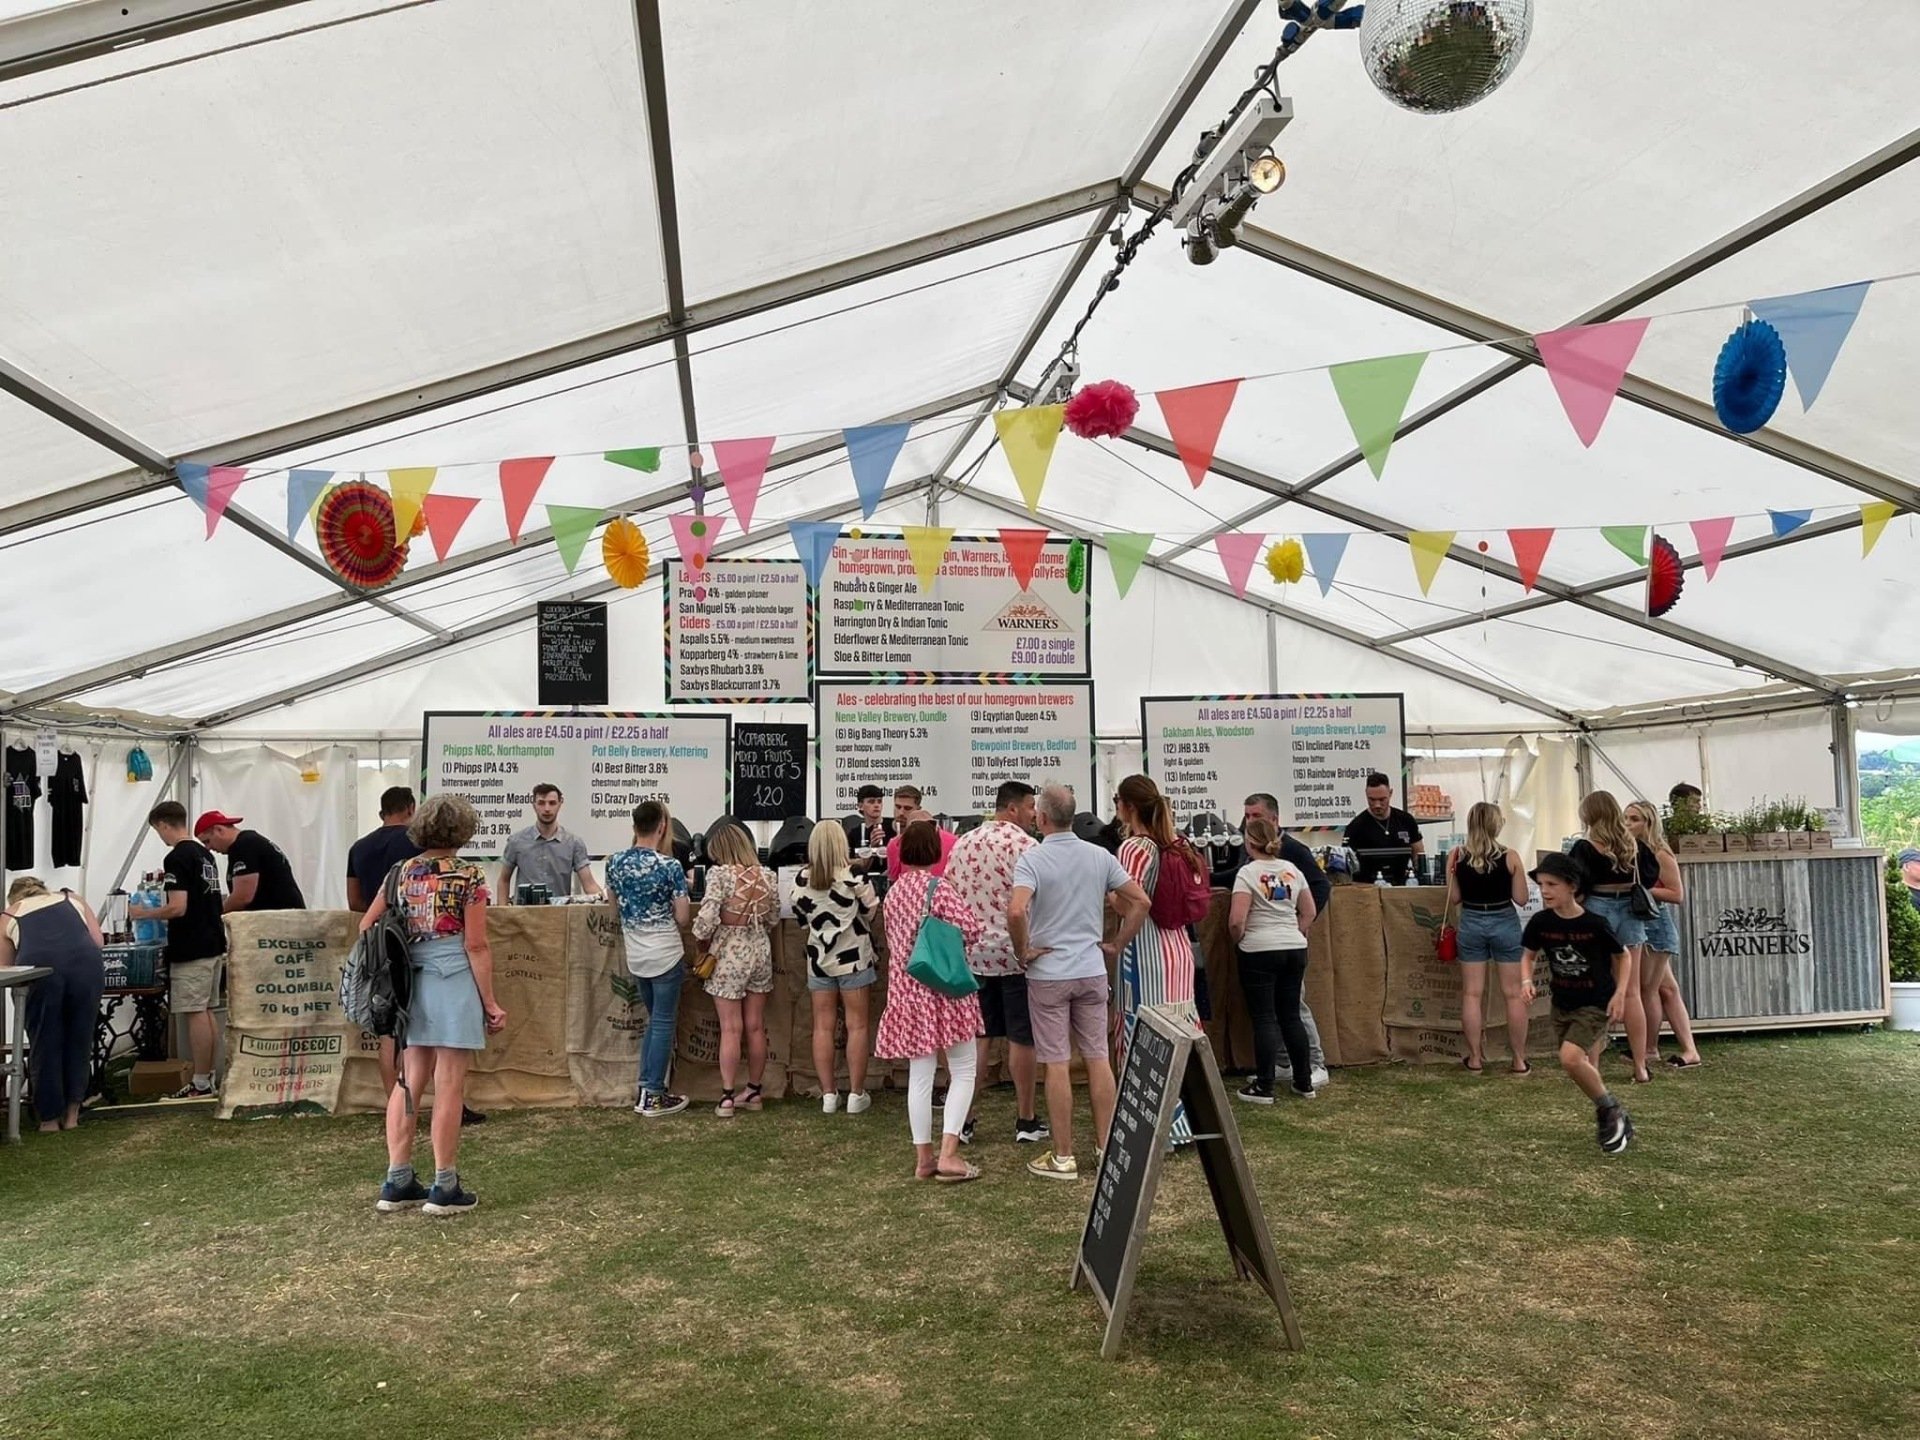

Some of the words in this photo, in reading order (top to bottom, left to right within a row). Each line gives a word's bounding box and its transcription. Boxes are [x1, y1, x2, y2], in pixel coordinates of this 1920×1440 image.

[833, 547, 847, 558] Gin
[872, 547, 912, 560] Harringt
[944, 550, 959, 562] gin,
[962, 550, 1000, 564] Warners,
[839, 562, 895, 575] homegrown,
[949, 565, 978, 576] stones
[981, 565, 1005, 576] throw
[679, 570, 711, 582] Lars
[679, 588, 706, 598] Prav
[708, 588, 720, 598] 4%
[834, 581, 867, 592] Rhubarb
[877, 582, 902, 594] Ginger
[905, 582, 916, 593] Ale
[679, 603, 694, 613] San
[696, 603, 723, 615] Miguel
[725, 603, 736, 613] 5%
[834, 599, 875, 611] Rasprry
[885, 600, 942, 611] Mediterranean
[944, 601, 964, 611] Tonic
[680, 616, 710, 629] Ciders
[834, 616, 876, 629] Harrington
[878, 617, 891, 628] Dry
[901, 617, 925, 628] Indian
[928, 617, 948, 628] Tonic
[680, 634, 709, 645] Aspalls
[711, 634, 729, 644] 5.5%
[834, 634, 879, 644] Elderflower
[889, 634, 946, 645] Mediterranean
[948, 635, 968, 646] Tonic
[1017, 637, 1039, 649] £7.00
[1049, 638, 1075, 651] single
[680, 649, 726, 660] Kopparberg
[727, 649, 739, 660] 4%
[834, 651, 852, 662] Sloe
[862, 652, 883, 662] Bitter
[885, 652, 911, 662] Lemon
[1012, 651, 1036, 664] £9.00
[1046, 652, 1075, 664] double
[680, 664, 709, 676] Saxbys
[711, 664, 743, 675] Rhubarb
[745, 664, 764, 675] 3.8%
[680, 680, 709, 691] Saxbys
[711, 680, 760, 690] Blackcurrant
[762, 679, 780, 690] 3.7%
[837, 693, 857, 705] Ales
[864, 693, 916, 706] celebrating
[920, 693, 933, 705] the
[935, 693, 954, 705] best
[957, 693, 966, 705] of
[968, 695, 982, 705] our
[985, 693, 1036, 706] homegrown
[1038, 693, 1074, 705] brewers
[835, 712, 855, 722] Nene
[858, 712, 882, 723] Valley
[883, 712, 918, 723] Brewery,
[920, 711, 947, 722] Oundle
[971, 711, 981, 721] (9)
[1016, 710, 1038, 721] Queen
[1040, 711, 1057, 720] 4.5%
[1199, 709, 1209, 720] All
[1211, 709, 1229, 720] ales
[1231, 710, 1245, 720] are
[1247, 708, 1271, 719] £4.50
[1281, 707, 1297, 720] pint
[1304, 707, 1327, 718] £2.25
[488, 725, 501, 738] All
[503, 725, 524, 738] ales
[527, 728, 542, 738] are
[545, 725, 573, 738] £4.50
[584, 727, 603, 740] pint
[611, 726, 640, 739] £2.25
[650, 726, 669, 739] half
[835, 728, 846, 739] (6)
[848, 728, 860, 740] Big
[862, 728, 881, 740] Bang
[883, 728, 908, 740] Theory
[910, 728, 928, 738] 5.3%
[1163, 727, 1194, 737] Oakham
[1196, 727, 1214, 737] Ales,
[1216, 726, 1254, 736] Woodston
[1291, 725, 1324, 736] Langtons
[1326, 724, 1356, 735] Brewery,
[1358, 724, 1386, 735] Langton
[443, 744, 473, 757] Phipps
[475, 744, 495, 756] NBC,
[497, 744, 554, 757] Northampton
[971, 740, 1011, 752] Brewpoint
[1012, 740, 1045, 751] Brewery,
[1047, 740, 1076, 750] Bedford
[1192, 742, 1210, 753] 3.8%
[1306, 741, 1332, 750] Inclined
[1334, 740, 1353, 750] Plane
[1354, 740, 1370, 750] 4.2%
[592, 745, 606, 756] Pot
[608, 745, 629, 758] Belly
[631, 746, 668, 758] Brewery,
[670, 746, 708, 758] Kettering
[442, 762, 452, 773] (1)
[454, 762, 482, 774] Phipps
[484, 762, 497, 773] IPA
[499, 762, 518, 773] 4.3%
[592, 762, 603, 774] (4)
[605, 763, 623, 773] Best
[625, 763, 647, 773] Bitter
[648, 763, 668, 774] 3.8%
[847, 757, 869, 768] Blond
[870, 757, 900, 768] session
[902, 757, 920, 767] 3.8%
[987, 756, 1018, 768] TollyFest
[1020, 756, 1042, 767] Tipple
[1043, 756, 1061, 766] 3.5%
[789, 762, 801, 779] 5
[1180, 771, 1205, 781] Inferno
[1308, 769, 1336, 778] Rainbow
[1337, 768, 1359, 779] Bridge
[442, 778, 479, 787] bittersweet
[481, 778, 503, 788] golden
[507, 793, 534, 804] Meado
[605, 793, 627, 805] Crazy
[1181, 800, 1197, 810] Citra
[484, 810, 522, 818] amber-gold
[490, 824, 511, 834] 3.8%
[482, 840, 496, 848] mild
[258, 939, 327, 949] EXCELSO
[1699, 934, 1810, 957] WARNER'S
[274, 952, 314, 965] CAFÉ
[285, 969, 305, 978] DE
[105, 976, 127, 986] IDER
[256, 982, 334, 994] COLOMBIA
[260, 1003, 277, 1013] 70
[282, 1004, 299, 1015] kg
[304, 1002, 331, 1011] NET
